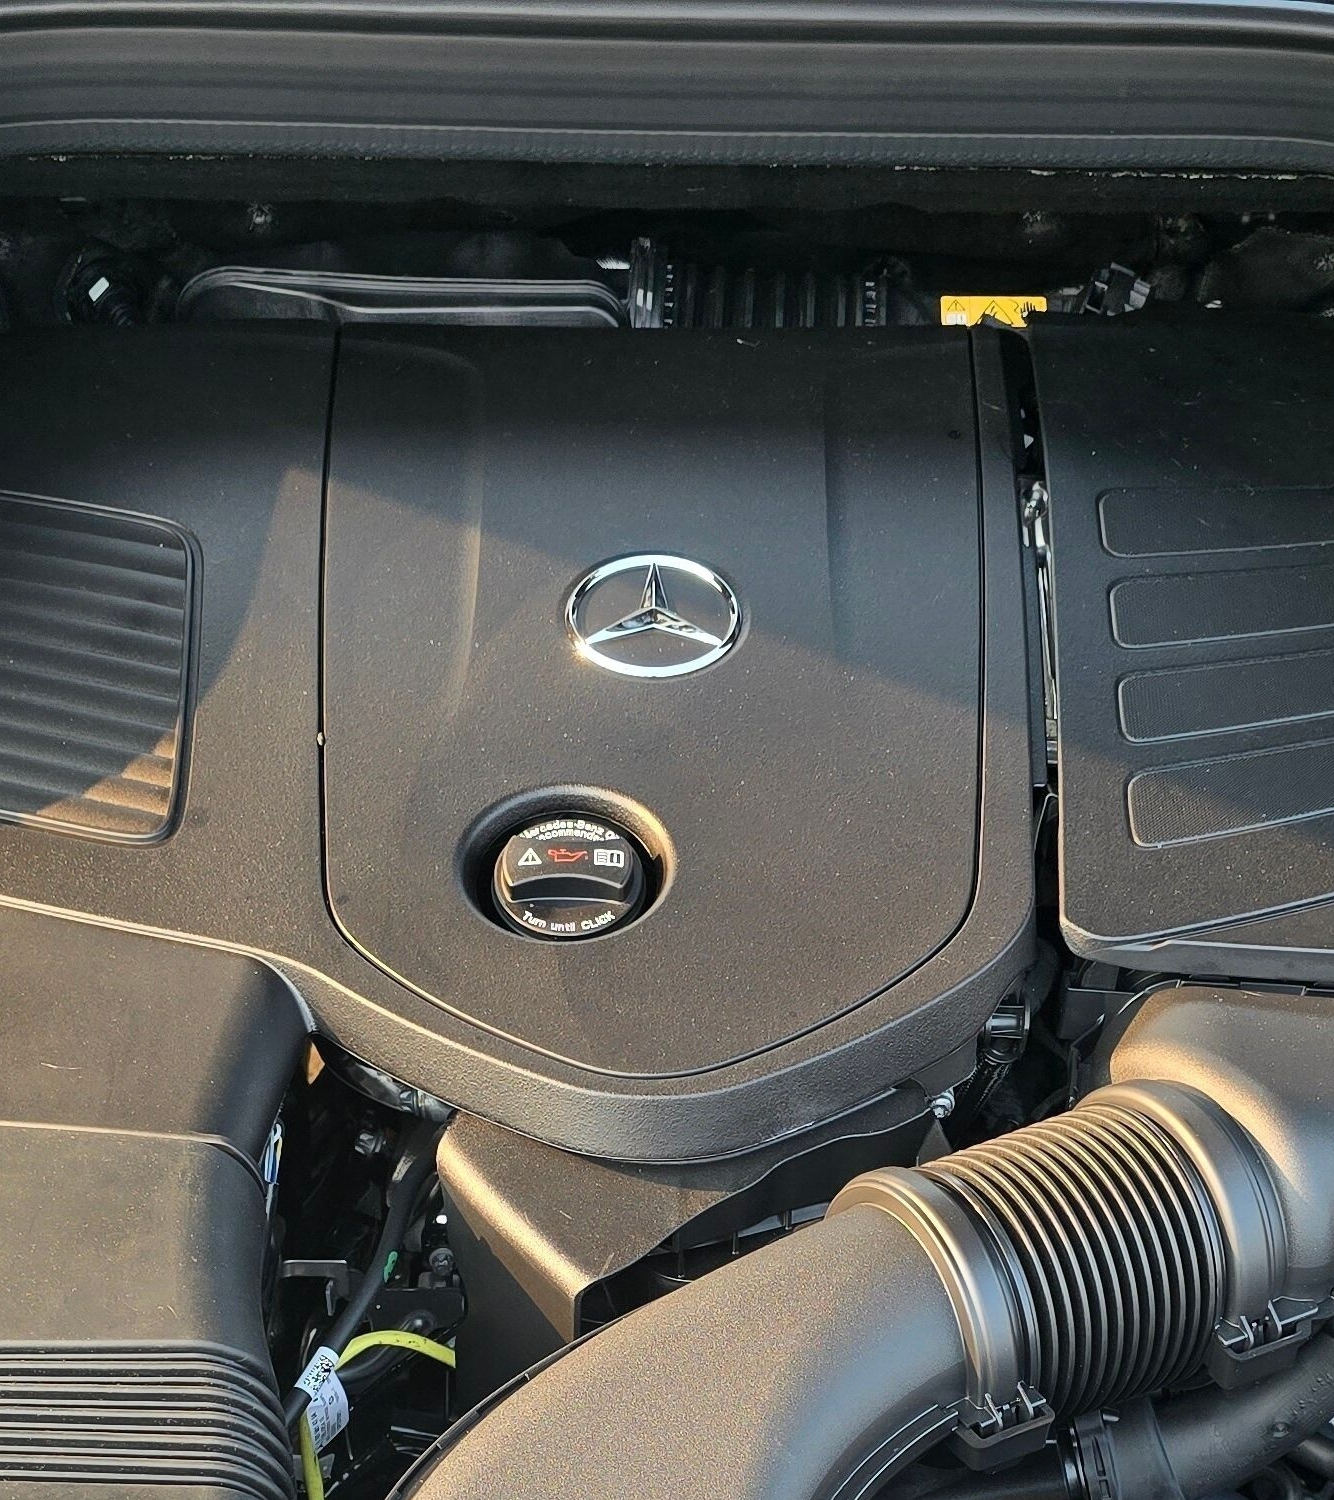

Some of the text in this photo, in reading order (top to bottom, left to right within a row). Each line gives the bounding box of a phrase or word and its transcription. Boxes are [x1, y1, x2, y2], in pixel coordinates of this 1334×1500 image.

[522, 910, 615, 931] Turn until CLICK
